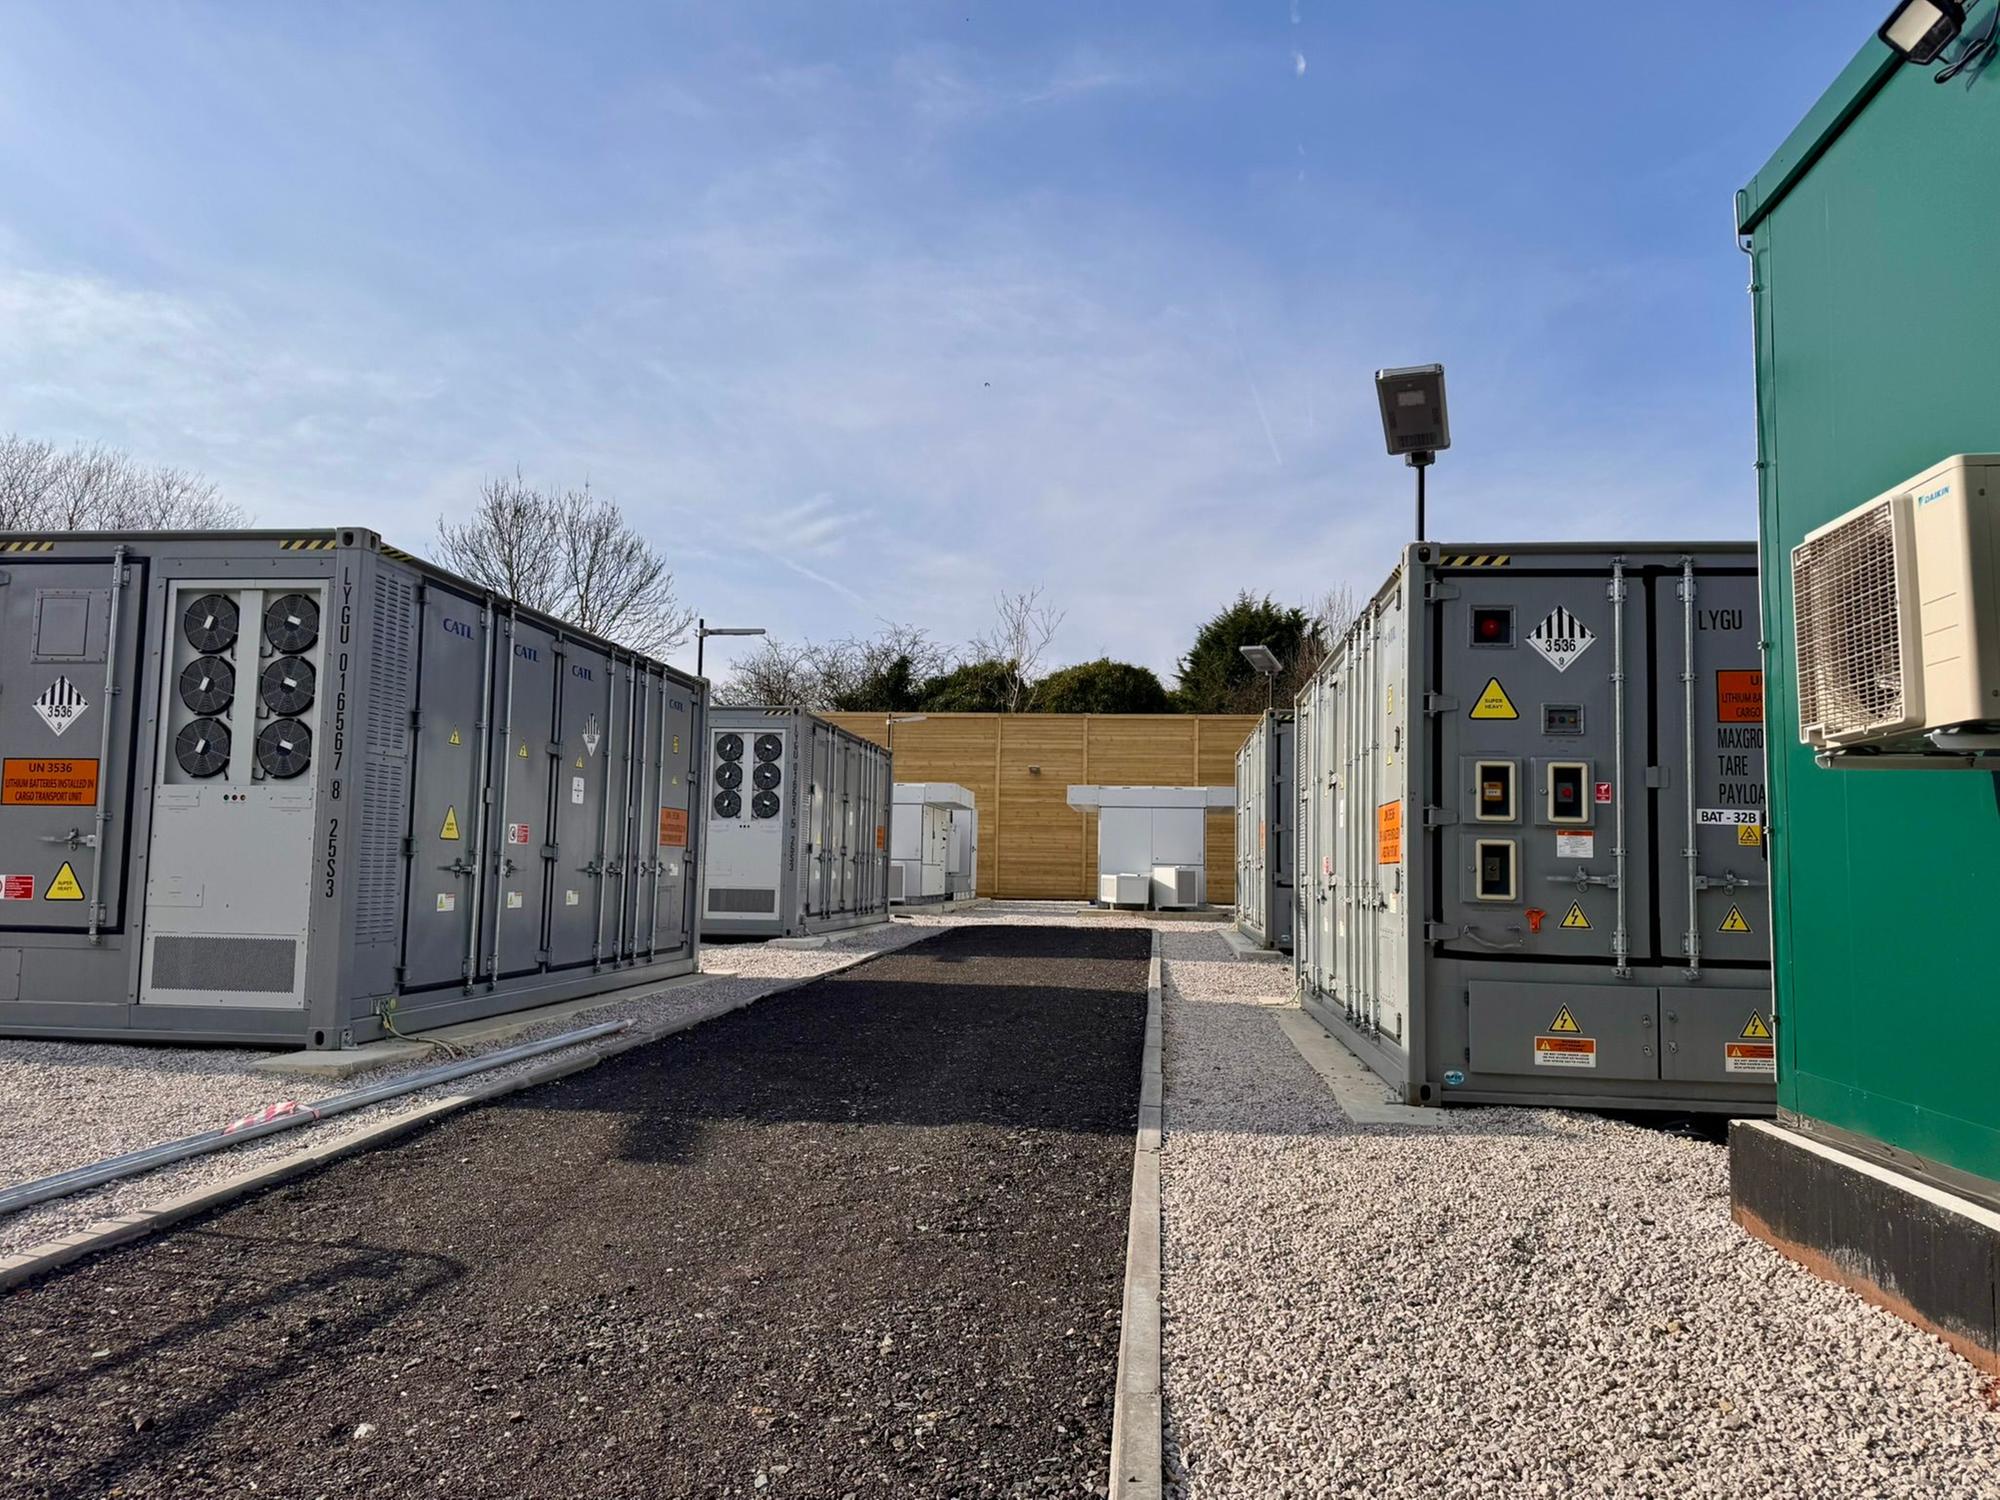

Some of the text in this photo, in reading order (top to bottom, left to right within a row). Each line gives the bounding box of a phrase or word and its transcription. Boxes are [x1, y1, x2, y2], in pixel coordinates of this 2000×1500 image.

[1924, 486, 1950, 503] DAIKIN
[1698, 609, 1743, 630] LYGU
[443, 618, 475, 640] CATL
[1545, 639, 1576, 652] 3536
[514, 644, 540, 662] CATL
[1559, 657, 1565, 665] 9
[571, 665, 594, 681] CATL
[1721, 692, 1751, 703] LITHIUM
[47, 705, 73, 718] 3536
[1736, 706, 1760, 718] CARGO
[325, 566, 352, 898] LYGU 016567 8 25S3
[29, 763, 73, 773] UN 3536
[1717, 755, 1748, 776] TARE
[5, 778, 28, 788] LITHIUM
[29, 778, 57, 788] BATTERIES
[58, 778, 87, 788] INSTALLED
[15, 791, 35, 801] CARGO
[35, 791, 68, 801] TRANSPORT
[1701, 811, 1724, 823] BAT
[1733, 812, 1757, 824] 32B
